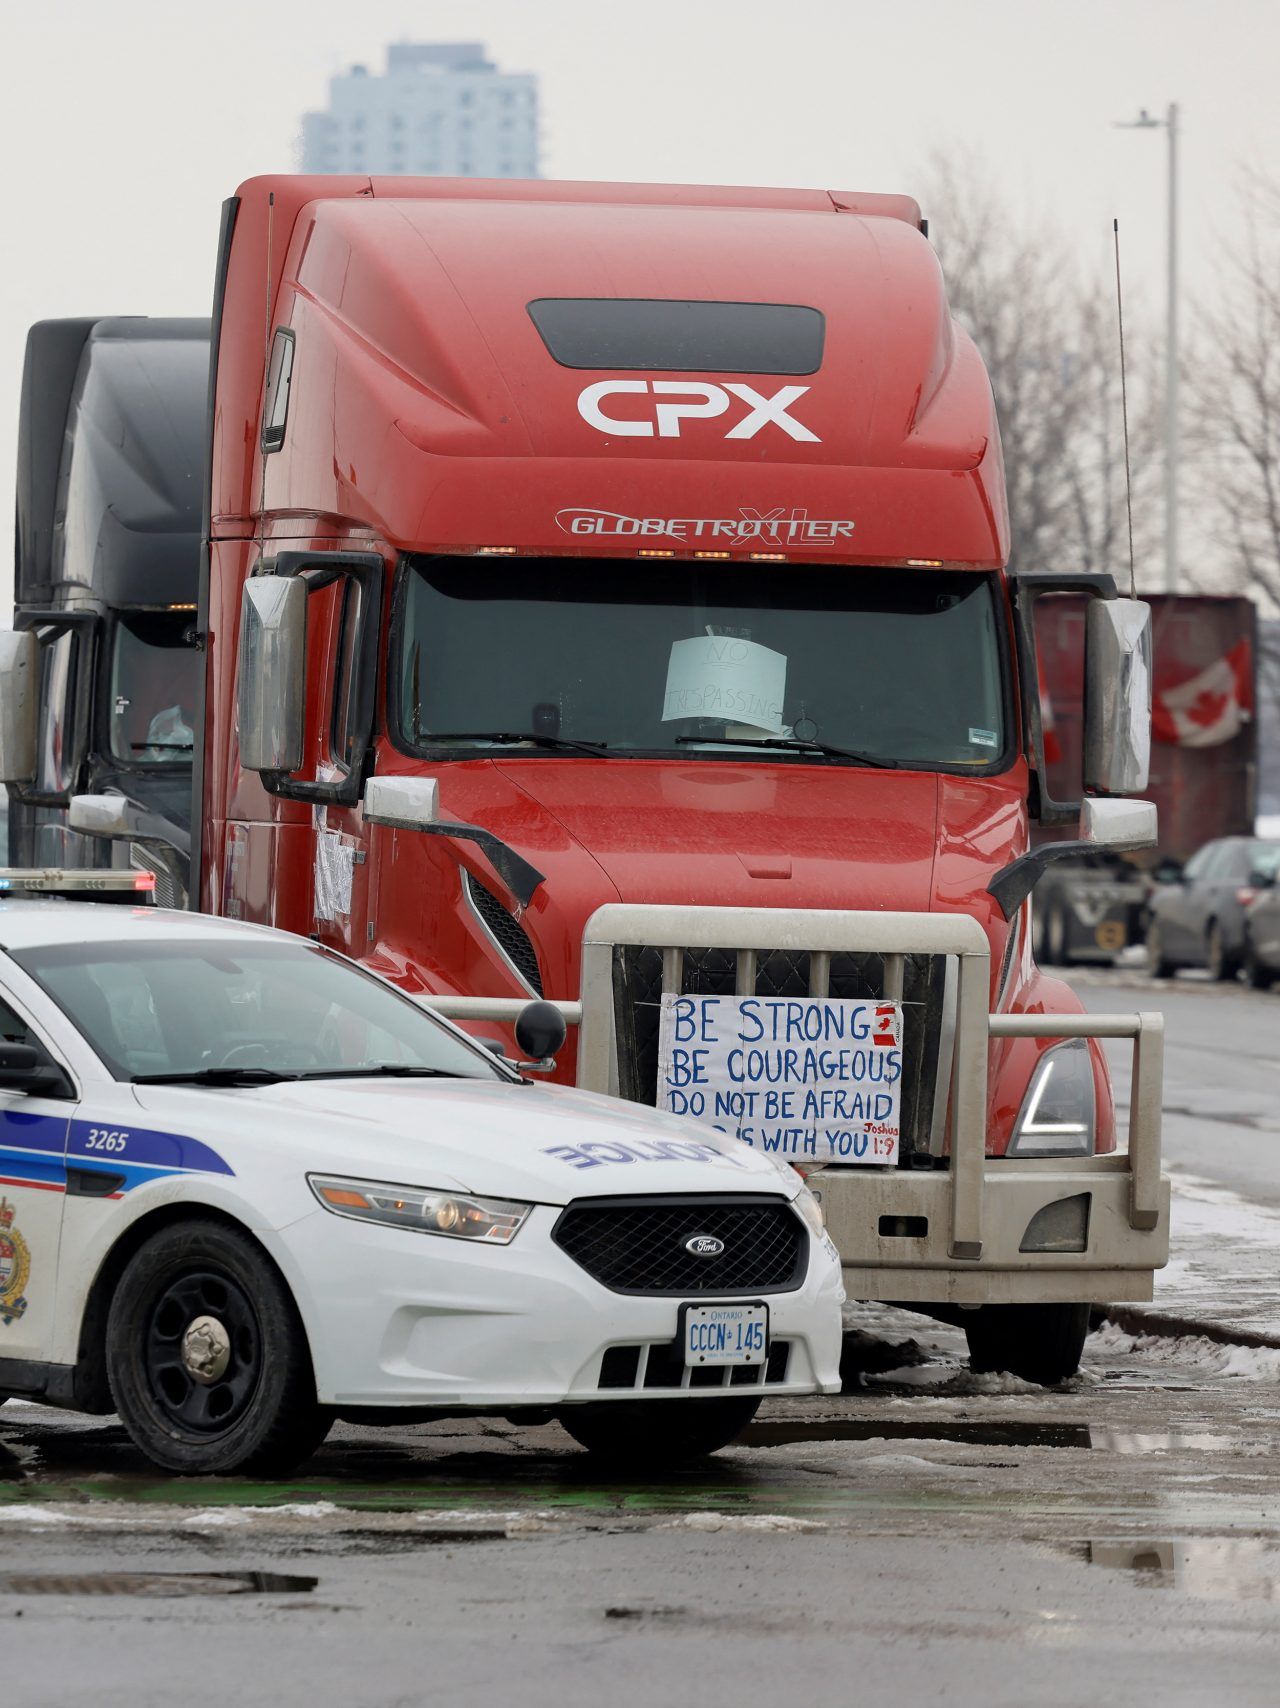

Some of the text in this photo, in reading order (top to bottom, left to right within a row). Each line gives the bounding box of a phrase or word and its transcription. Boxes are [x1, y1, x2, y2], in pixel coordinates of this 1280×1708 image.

[577, 380, 823, 442] CPX
[570, 515, 855, 538] GLOBETROTTER
[707, 640, 749, 661] NO
[667, 684, 780, 719] TRESPASSING
[672, 998, 871, 1042] BE STRONG
[666, 1048, 902, 1087] BE COURAGEOUS
[667, 1089, 893, 1121] DO NOT BE AFRAID
[85, 1128, 129, 1152] 3265
[863, 1122, 899, 1137] Joshua
[762, 1128, 817, 1155] WITH
[825, 1129, 869, 1158] YOU
[873, 1137, 895, 1156] 1:9
[697, 1240, 718, 1252] Ford
[710, 1310, 742, 1321] ONTARIO
